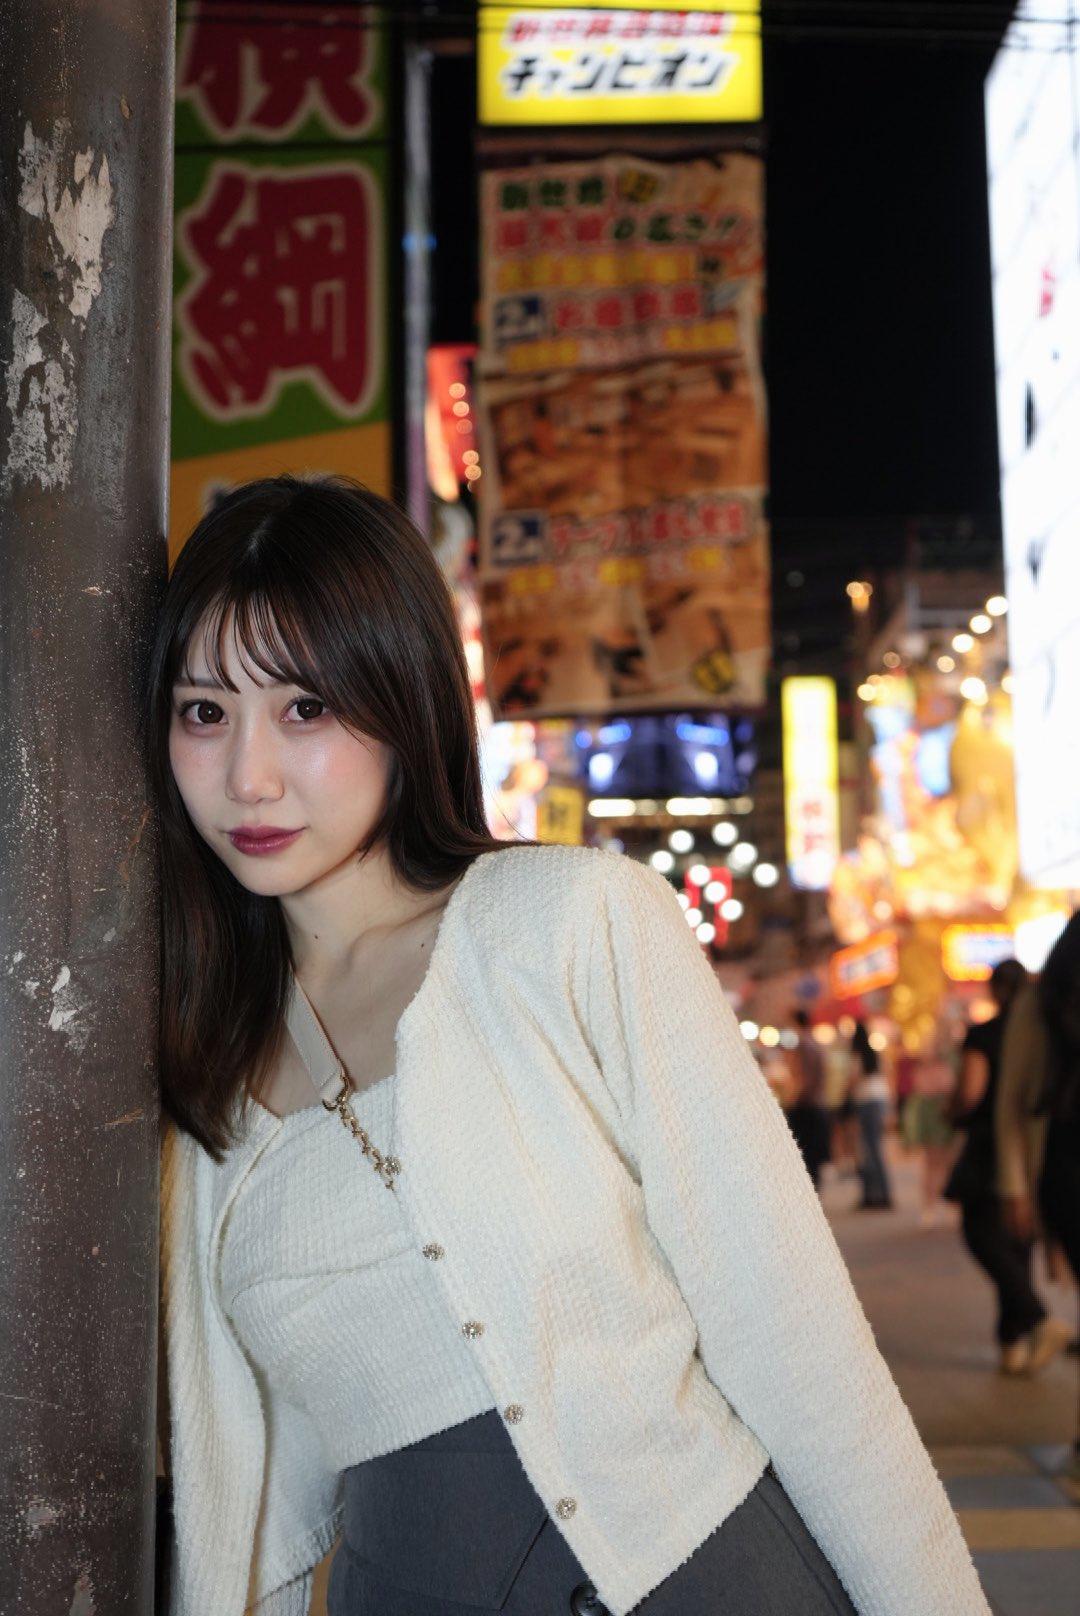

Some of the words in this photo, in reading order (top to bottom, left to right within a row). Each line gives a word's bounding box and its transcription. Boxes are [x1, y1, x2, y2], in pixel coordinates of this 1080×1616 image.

[506, 50, 724, 91] チャンピオン
